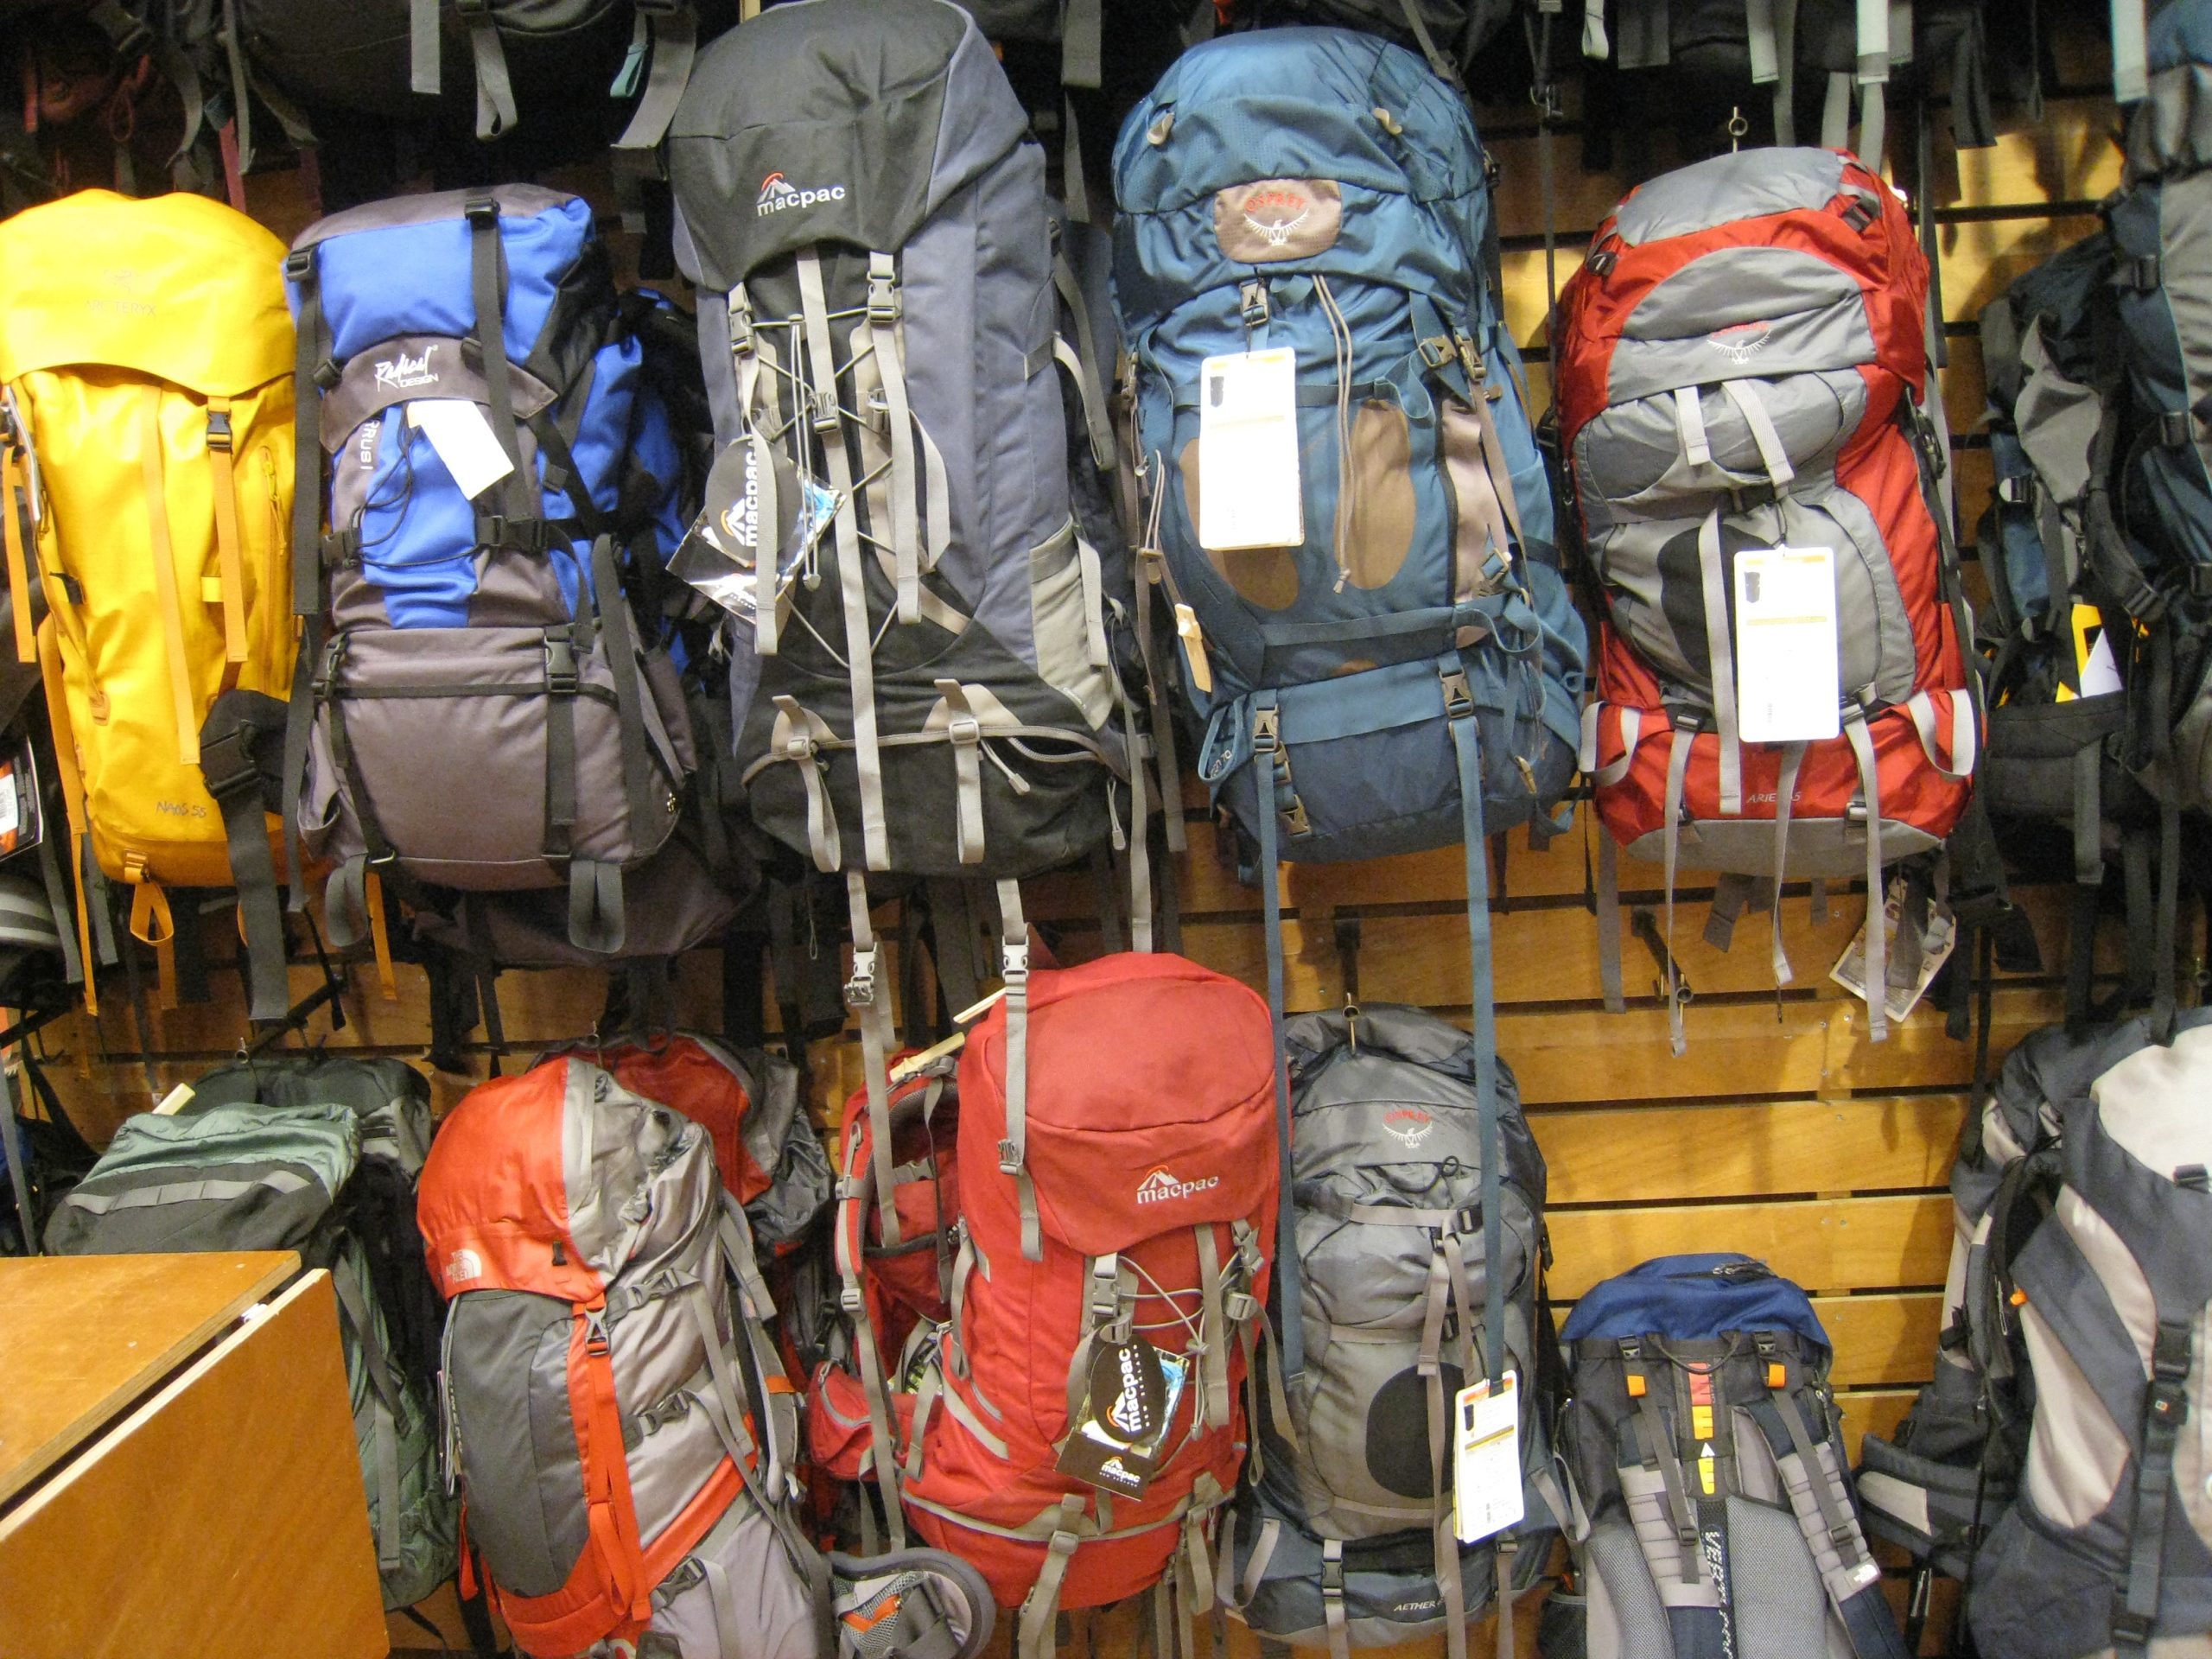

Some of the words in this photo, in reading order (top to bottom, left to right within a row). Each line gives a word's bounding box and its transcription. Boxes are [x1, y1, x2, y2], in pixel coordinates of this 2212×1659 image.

[756, 187, 847, 217] macpac
[1244, 192, 1306, 213] OSPREY
[399, 373, 439, 388] DESIGN
[1746, 792, 1778, 804] ARIE
[1136, 1175, 1220, 1205] macpac
[1118, 1348, 1142, 1432] macpac
[1393, 1600, 1437, 1612] AETHER
